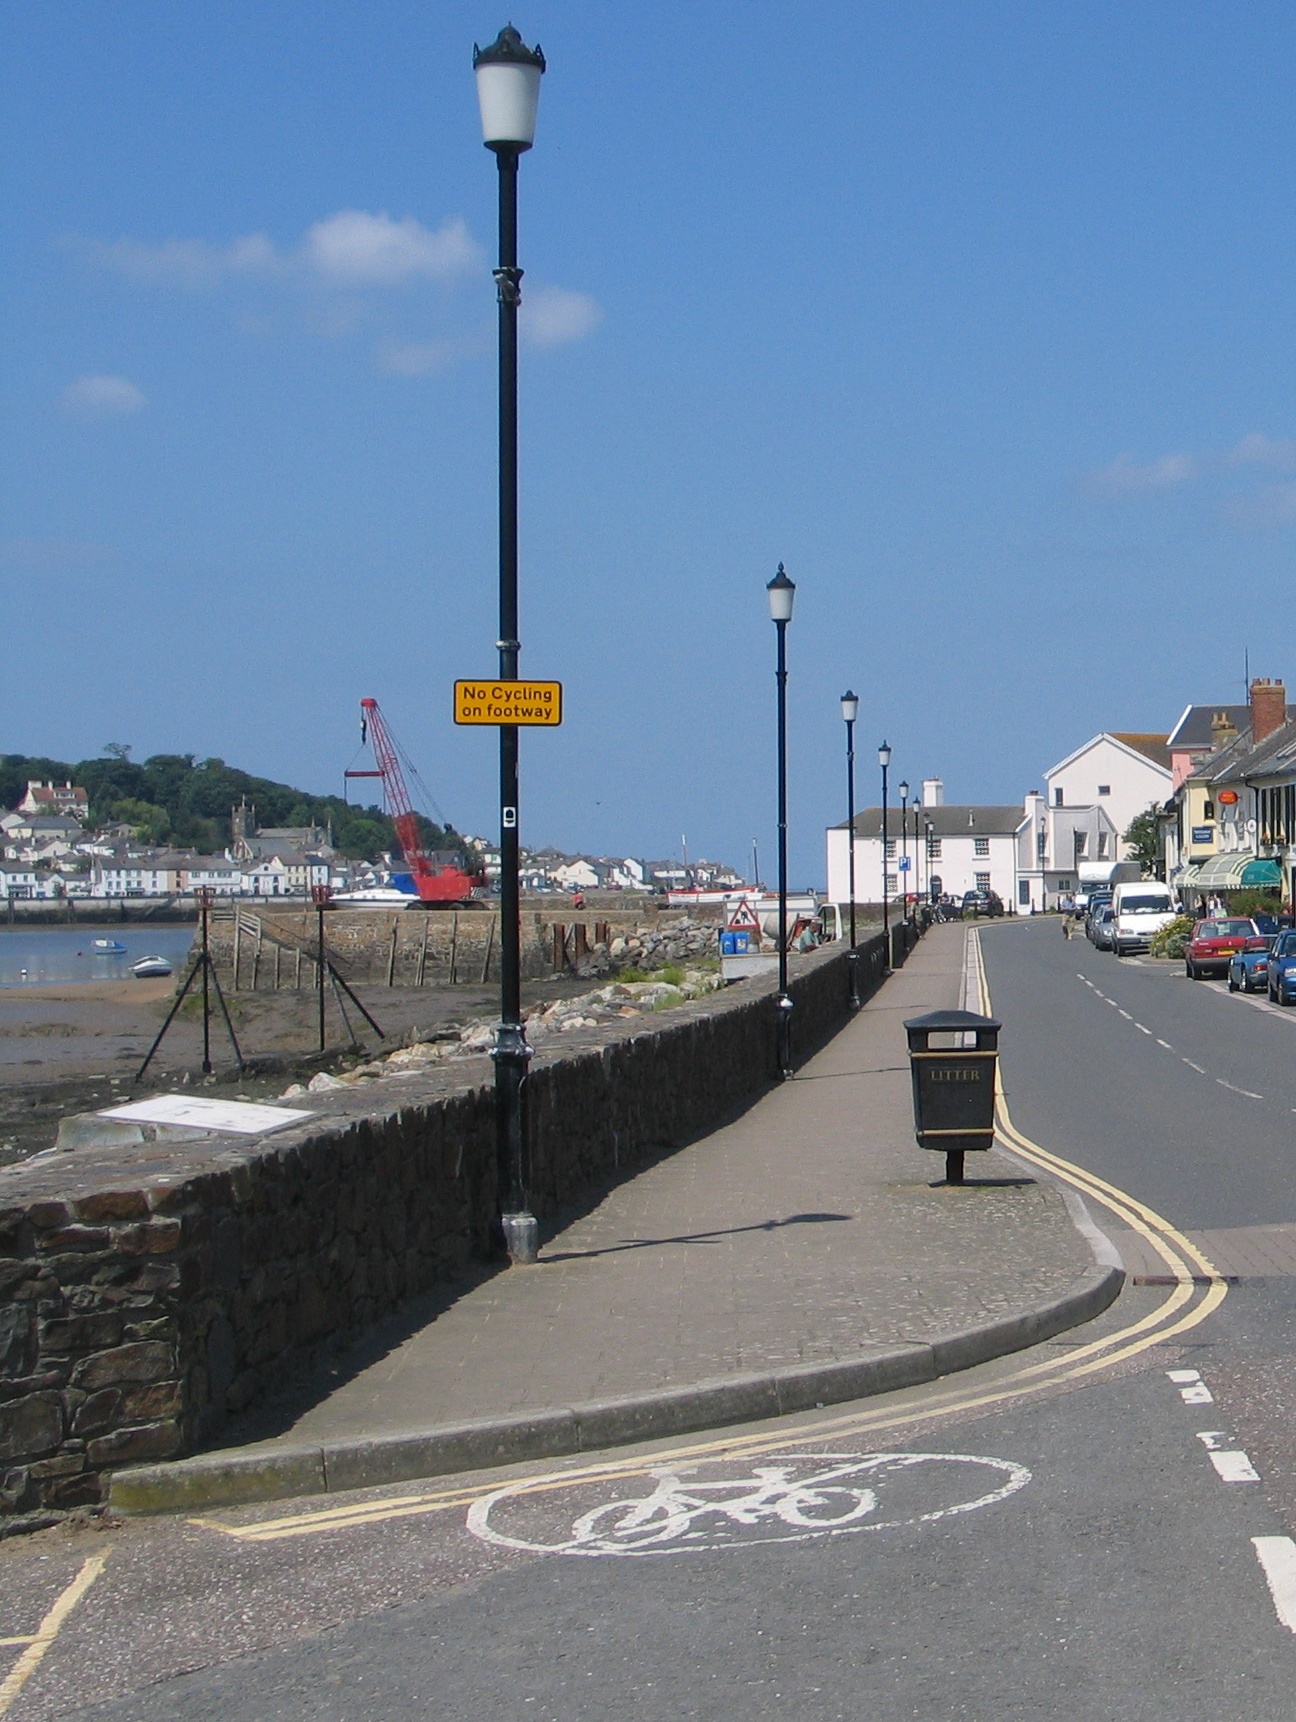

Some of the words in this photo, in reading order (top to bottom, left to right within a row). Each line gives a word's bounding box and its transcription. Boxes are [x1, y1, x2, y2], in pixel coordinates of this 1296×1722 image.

[463, 687, 486, 700] No
[491, 687, 552, 703] Cycling
[462, 706, 482, 717] on
[487, 704, 553, 719] footway
[931, 1070, 980, 1081] LITTER
